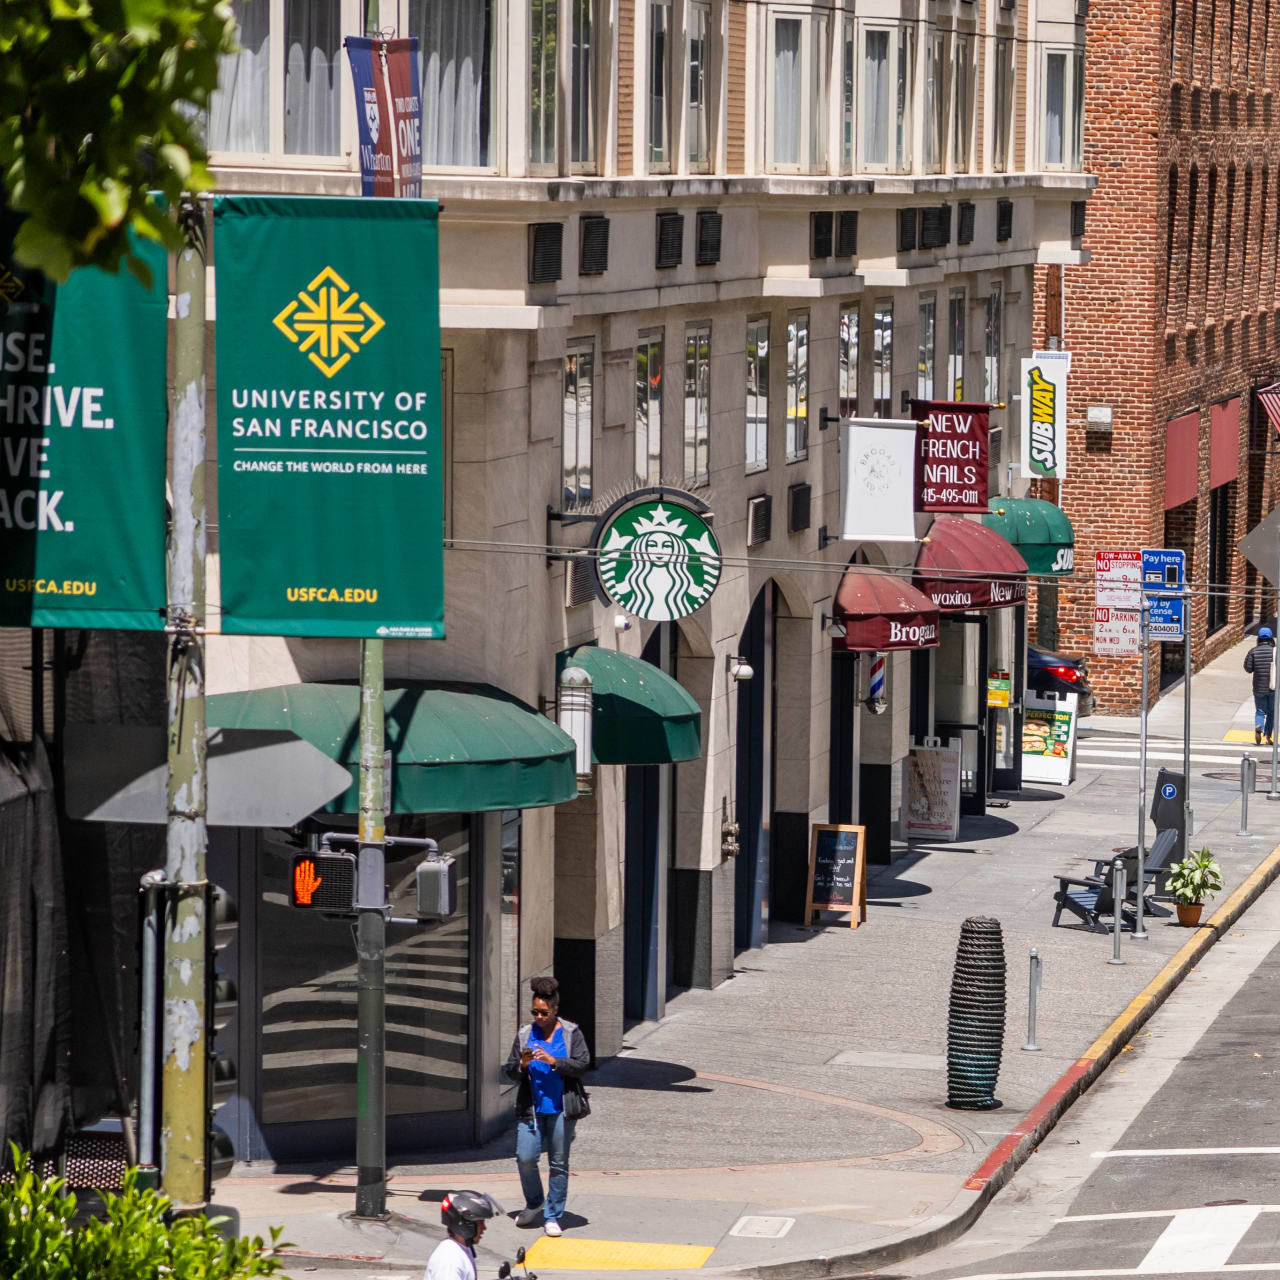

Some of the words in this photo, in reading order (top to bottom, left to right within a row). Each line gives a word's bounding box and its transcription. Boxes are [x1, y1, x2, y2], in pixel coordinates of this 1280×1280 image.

[398, 118, 420, 157] ONE
[361, 145, 392, 171] Wharton
[231, 388, 385, 411] UNIVERSITY
[394, 391, 427, 412] OF
[929, 413, 972, 434] NEW
[1029, 367, 1057, 470] SUBWAY
[231, 417, 281, 437] SAN
[290, 418, 428, 441] FRANCISCO
[921, 439, 980, 460] FRENCH
[233, 460, 284, 473] CHANGE
[285, 461, 309, 473] THE
[310, 461, 354, 474] WORLD
[356, 462, 393, 475] FROM
[396, 463, 428, 475] HERE
[924, 464, 976, 485] NAILS
[921, 488, 979, 504] 415-495-0111
[1097, 560, 1109, 570] NO
[1111, 561, 1140, 569] STOPPING
[1100, 552, 1137, 560] TOW-AWAY
[1143, 554, 1160, 564] Pay
[1160, 554, 1181, 563] here
[5, 577, 97, 596] USFCA.EDU
[286, 587, 378, 603] USFCA.EDU
[931, 590, 971, 608] waxing
[990, 582, 1012, 603] New
[1096, 608, 1109, 621] NO
[1110, 612, 1139, 622] PARKING
[1149, 607, 1173, 615] cense
[889, 621, 936, 646] Brogan
[1095, 636, 1107, 644] MON
[1109, 637, 1120, 645] WED
[1128, 637, 1137, 645] FRI
